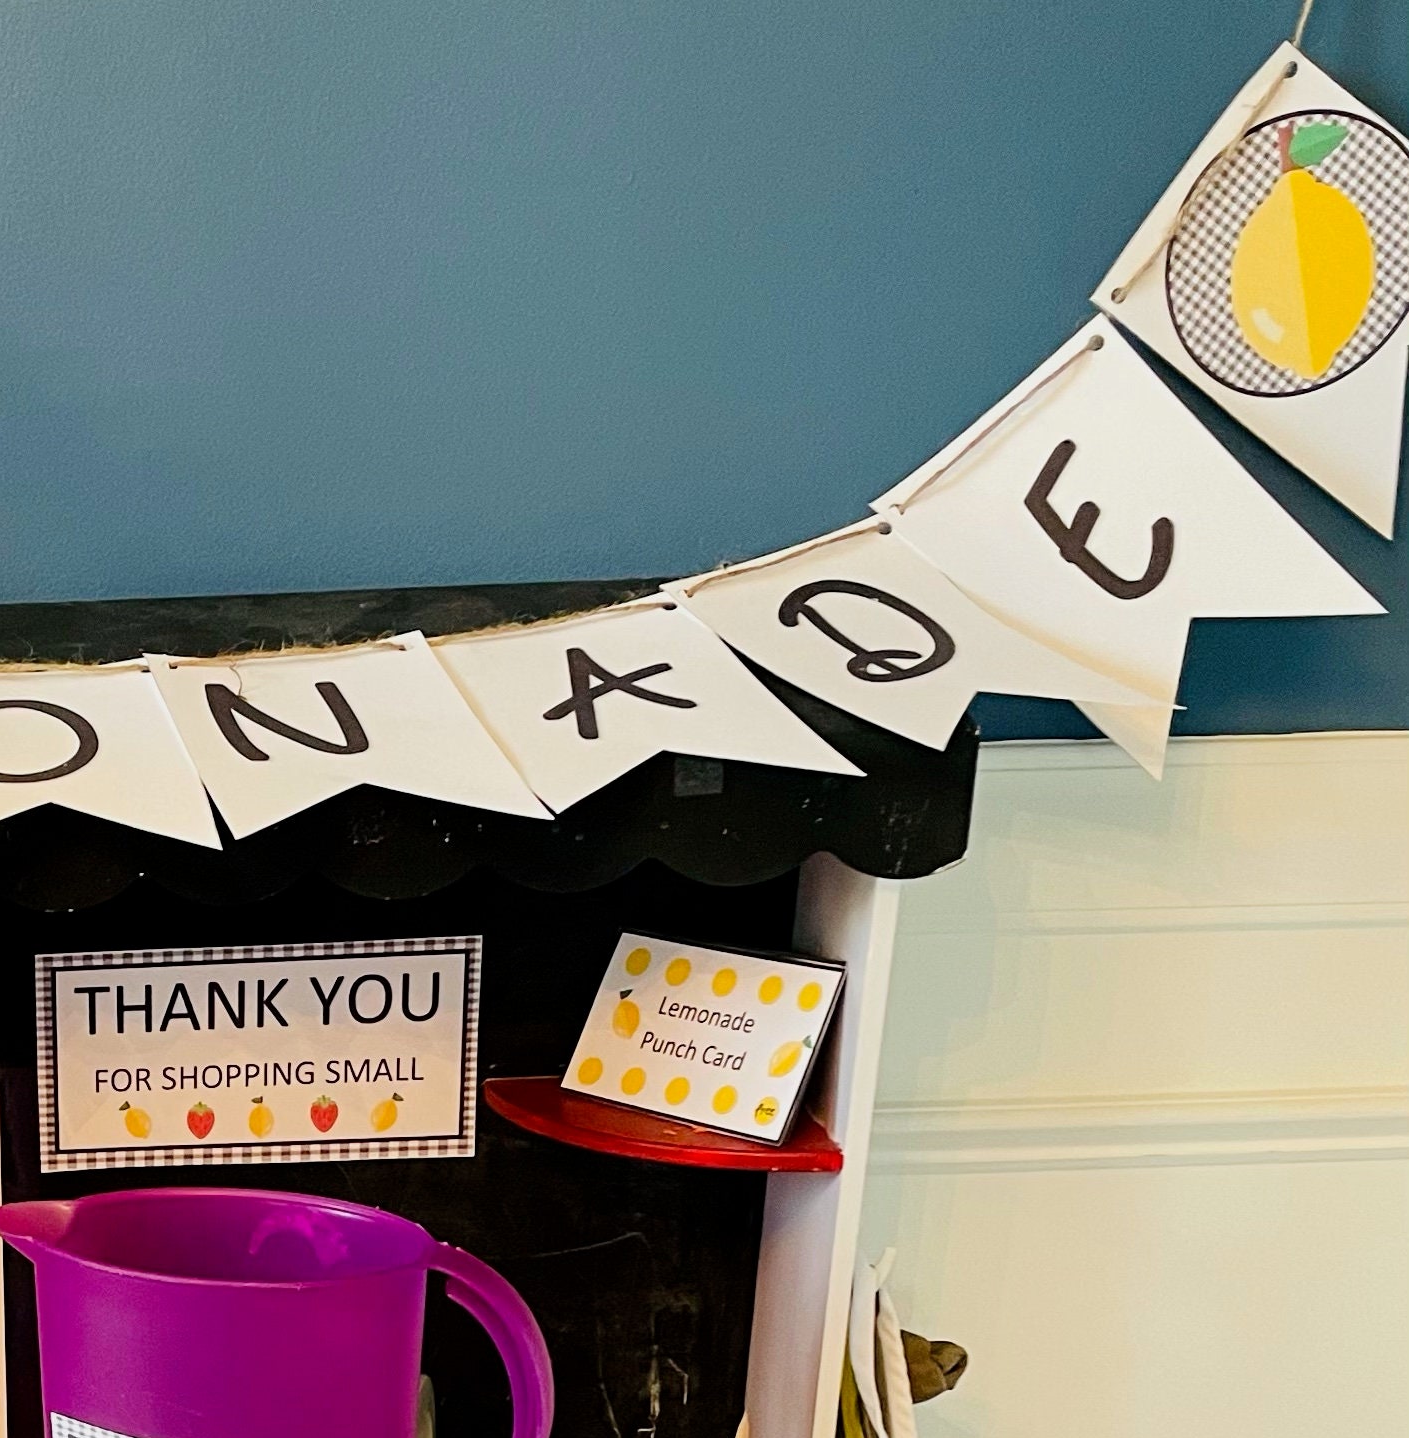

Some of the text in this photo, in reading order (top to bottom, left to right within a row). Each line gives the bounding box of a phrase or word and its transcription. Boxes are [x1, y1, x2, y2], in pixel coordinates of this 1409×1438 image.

[74, 971, 441, 1035] THANK YOU
[658, 996, 755, 1033] Lemonade
[640, 1031, 746, 1070] Punch Card
[95, 1057, 425, 1093] FOR SHOPPING SMALL
